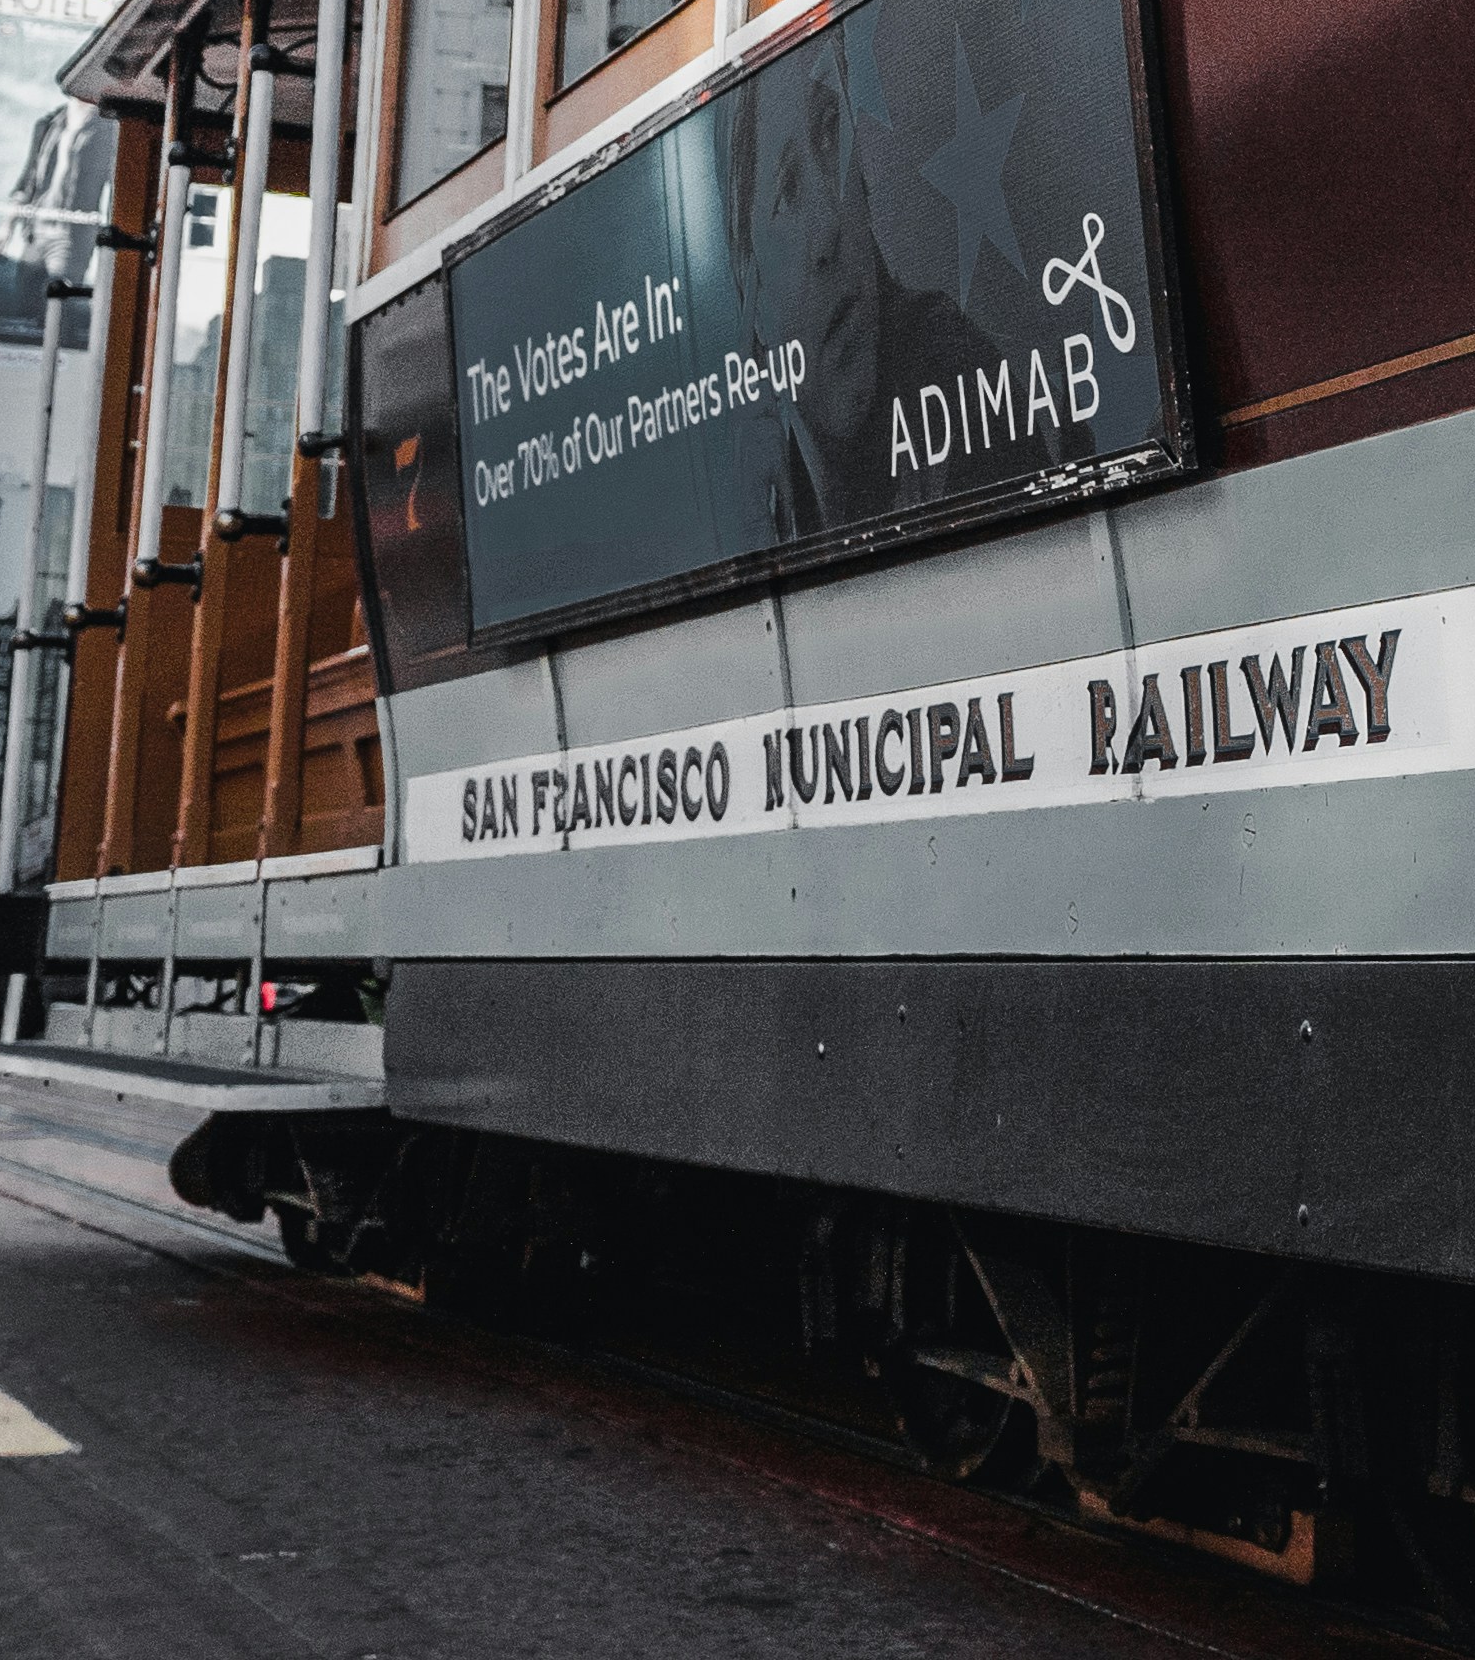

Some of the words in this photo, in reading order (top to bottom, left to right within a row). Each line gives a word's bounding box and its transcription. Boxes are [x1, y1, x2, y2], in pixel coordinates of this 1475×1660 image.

[467, 358, 511, 425] The
[514, 327, 586, 402] Votes
[594, 301, 640, 371] Are
[645, 274, 683, 343] In:
[475, 459, 514, 507] Over
[518, 431, 559, 490] 70%
[562, 416, 583, 474] of
[585, 412, 624, 465] Our
[627, 373, 722, 448] Partners
[725, 338, 806, 409] Re-up
[891, 333, 1101, 477] ADIMAB
[462, 776, 519, 842] SAN
[532, 741, 730, 836] FRANCISCO
[1087, 628, 1402, 775] RAILWAY
